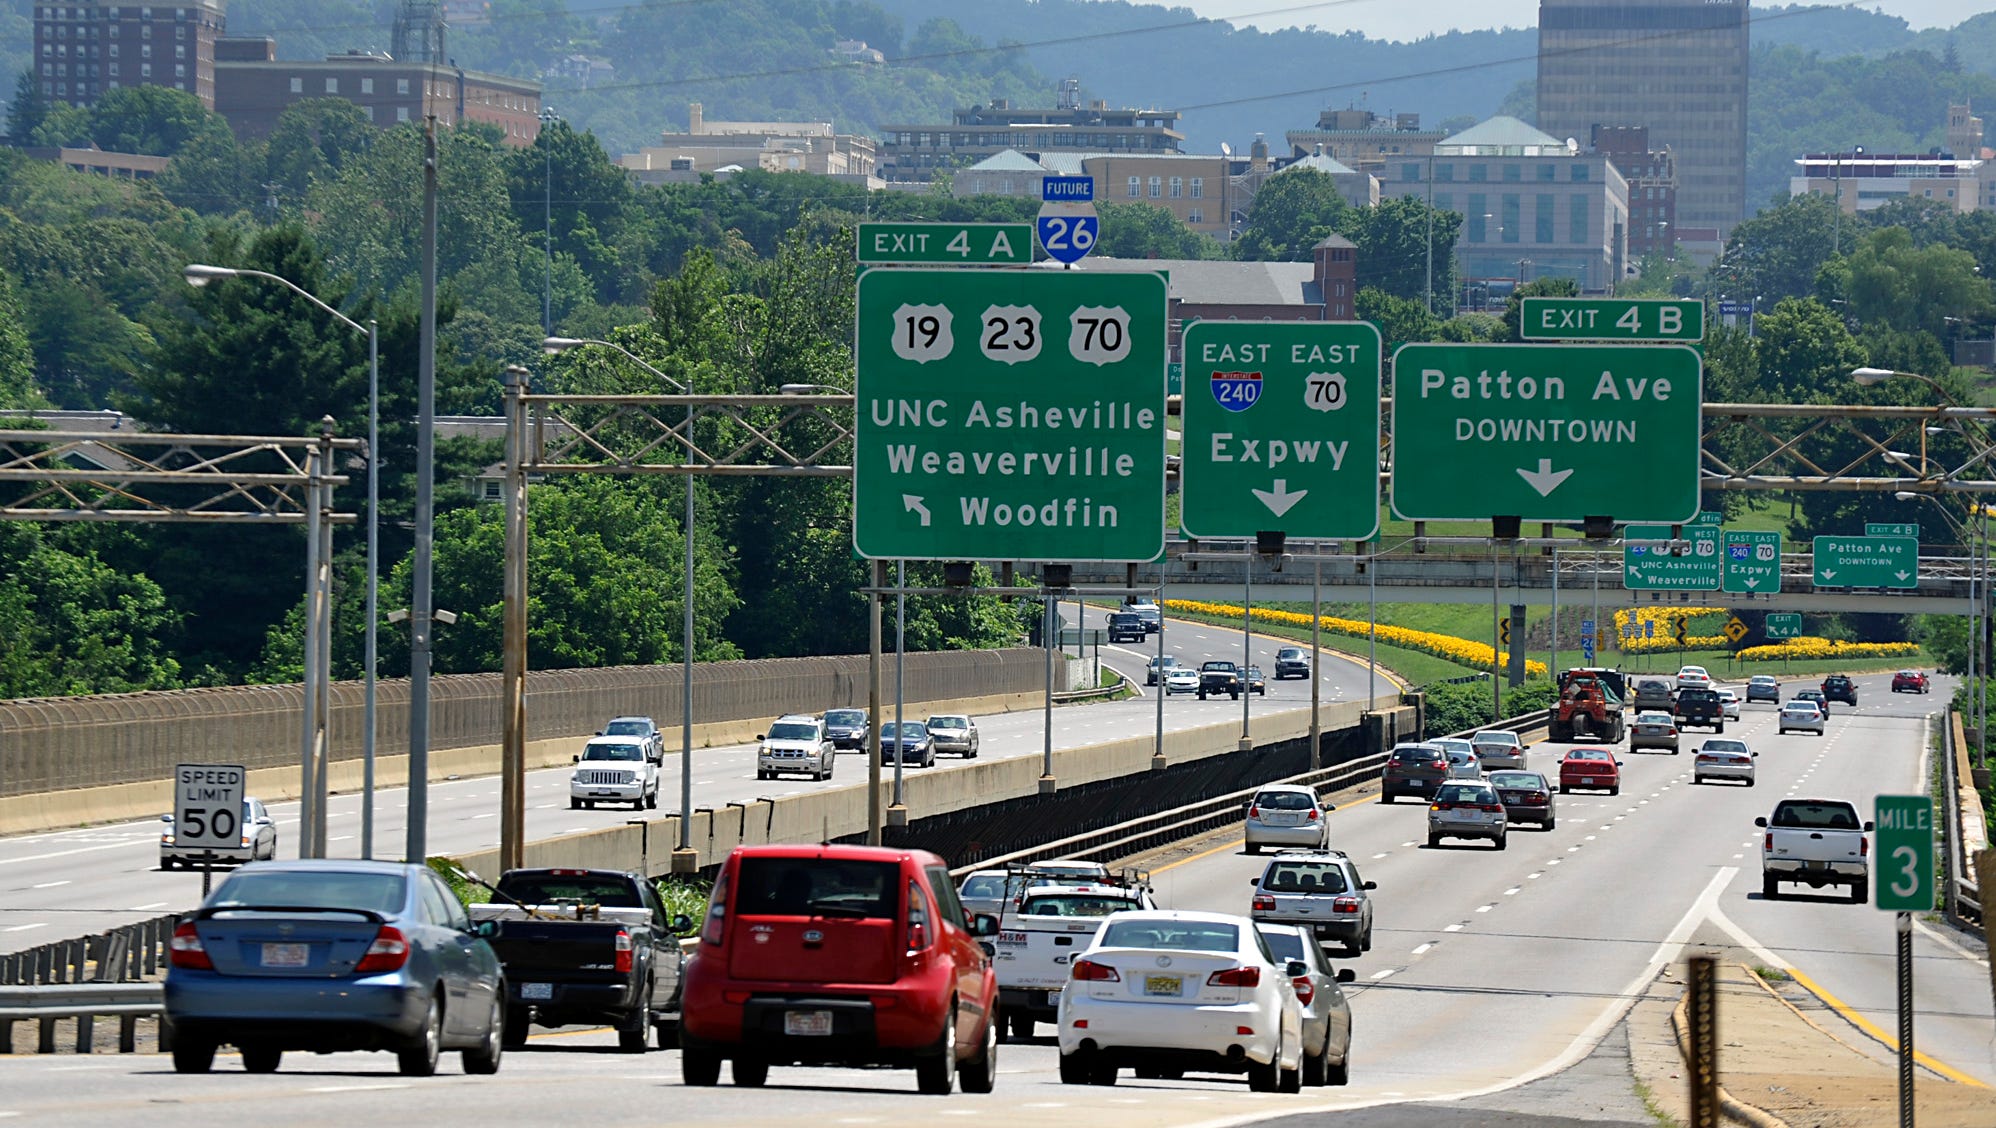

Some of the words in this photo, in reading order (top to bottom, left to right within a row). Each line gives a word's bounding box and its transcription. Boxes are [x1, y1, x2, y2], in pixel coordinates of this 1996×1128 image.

[1046, 181, 1090, 196] FUTURE
[1046, 217, 1094, 250] 26
[875, 233, 930, 253] EXIT
[945, 229, 971, 258] 4
[988, 230, 1014, 258] A
[1542, 309, 1599, 329] EXIT
[1615, 306, 1642, 333] 4
[1660, 306, 1683, 334] B
[906, 315, 940, 349] 19
[986, 316, 1036, 351] 23
[1077, 318, 1123, 352] 70
[1203, 343, 1271, 363] EAST
[1291, 344, 1360, 363] EAST
[1219, 382, 1256, 402] 240
[1310, 380, 1341, 403] 70
[1421, 369, 1565, 400] Patton
[1592, 370, 1672, 401] Ave
[871, 399, 948, 427] UNC
[965, 400, 1155, 429] Asheville
[1456, 418, 1636, 443] DOWNTOWN
[1211, 432, 1349, 471] Expwy
[887, 444, 1134, 477] Weaverville
[960, 497, 1118, 528] Woodfin
[1701, 514, 1720, 522] dfin
[1695, 530, 1716, 538] WEST
[1892, 525, 1901, 534] 4
[1905, 526, 1913, 535] B
[1729, 534, 1750, 542] EAST
[1755, 535, 1777, 543] EAST
[1698, 543, 1713, 554] 70
[1732, 547, 1748, 557] 240
[1758, 546, 1773, 558] 70
[1828, 543, 1872, 553] Patton
[1879, 543, 1903, 554] Ave
[1641, 561, 1663, 569] UNC
[1665, 561, 1718, 570] Asheville
[1838, 557, 1893, 566] DOWNTOWN
[1730, 564, 1772, 577] Expwy
[1647, 575, 1716, 586] Weaverville
[1780, 626, 1789, 636] 4
[1791, 626, 1800, 636] A
[182, 770, 240, 785] SPEED
[187, 788, 232, 802] LIMIT
[182, 808, 236, 839] 50
[1878, 808, 1929, 830] MILE
[1890, 845, 1919, 898] 3
[999, 932, 1027, 942] H&M
